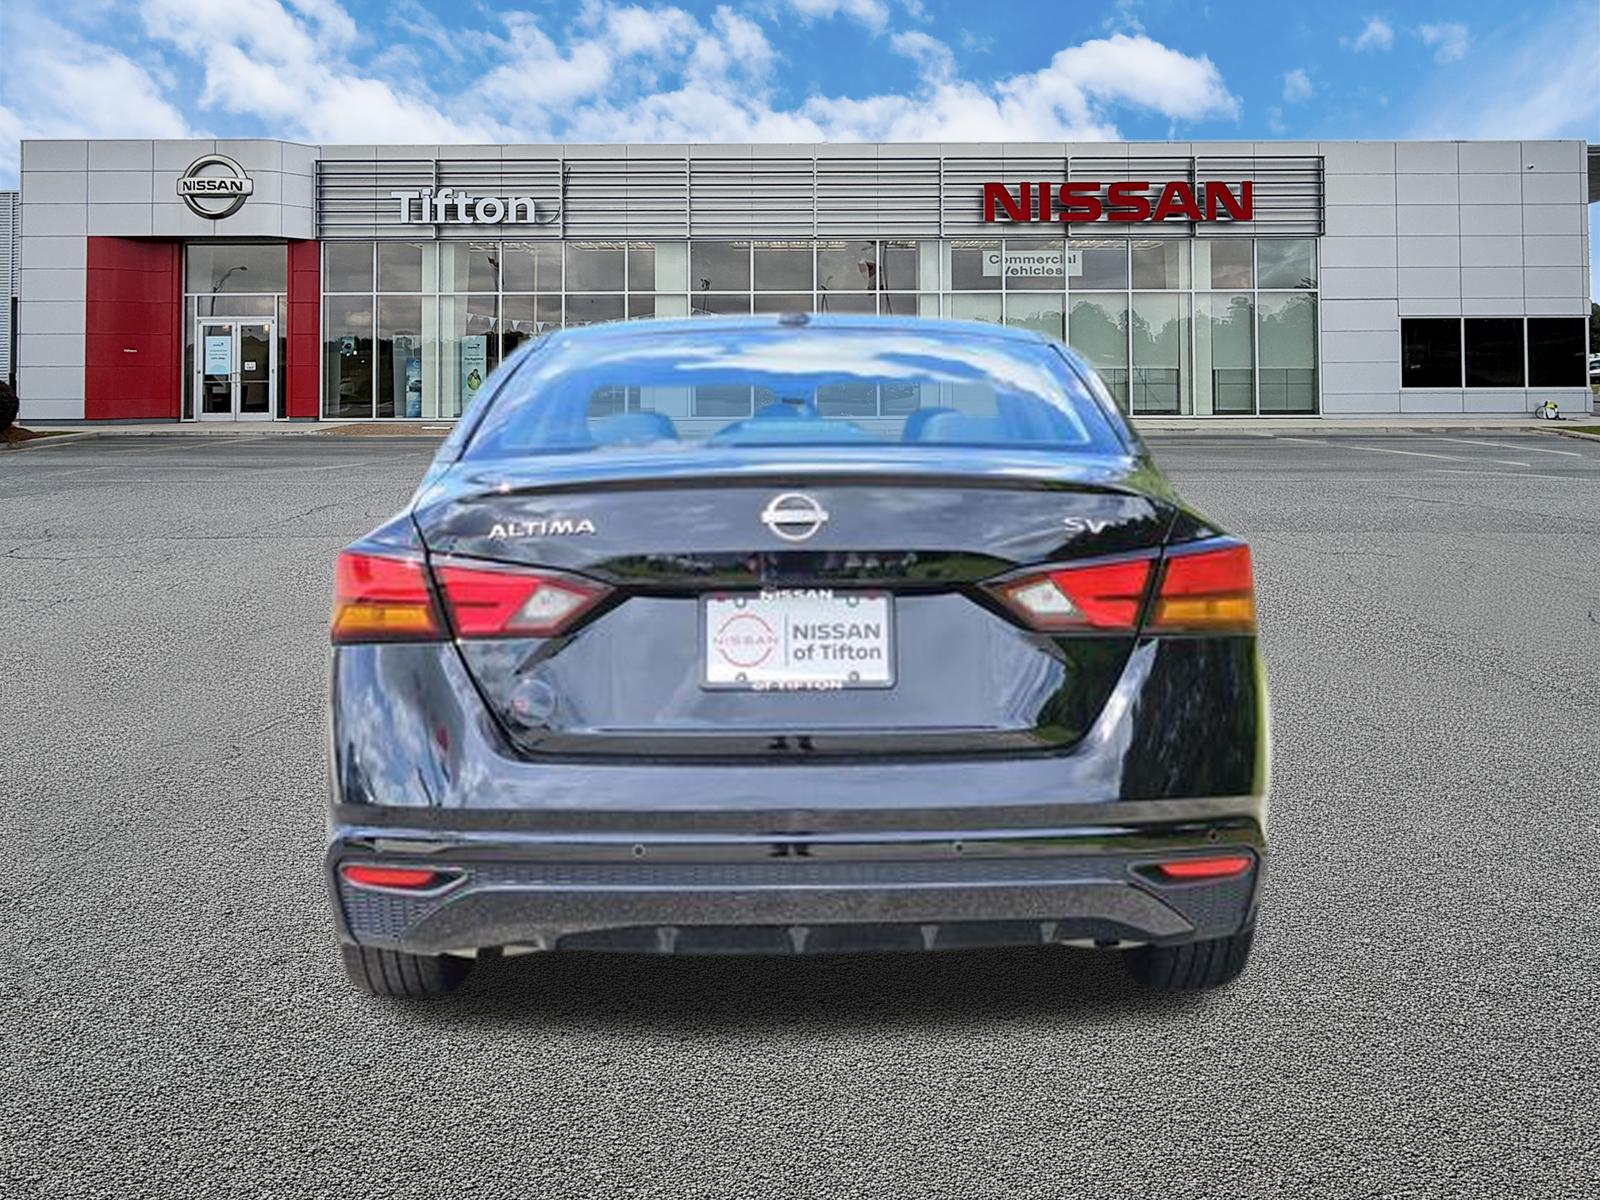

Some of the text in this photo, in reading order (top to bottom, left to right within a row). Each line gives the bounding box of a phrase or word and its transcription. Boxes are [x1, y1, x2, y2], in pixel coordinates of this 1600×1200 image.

[182, 180, 243, 192] NISSAN
[391, 188, 536, 224] Tifton
[983, 181, 1253, 222] NISSAN
[488, 519, 596, 540] ALTIMA
[1064, 517, 1106, 534] SV
[760, 589, 833, 600] NISSAN
[793, 623, 880, 640] NISSAN
[794, 643, 881, 660] of Tifton
